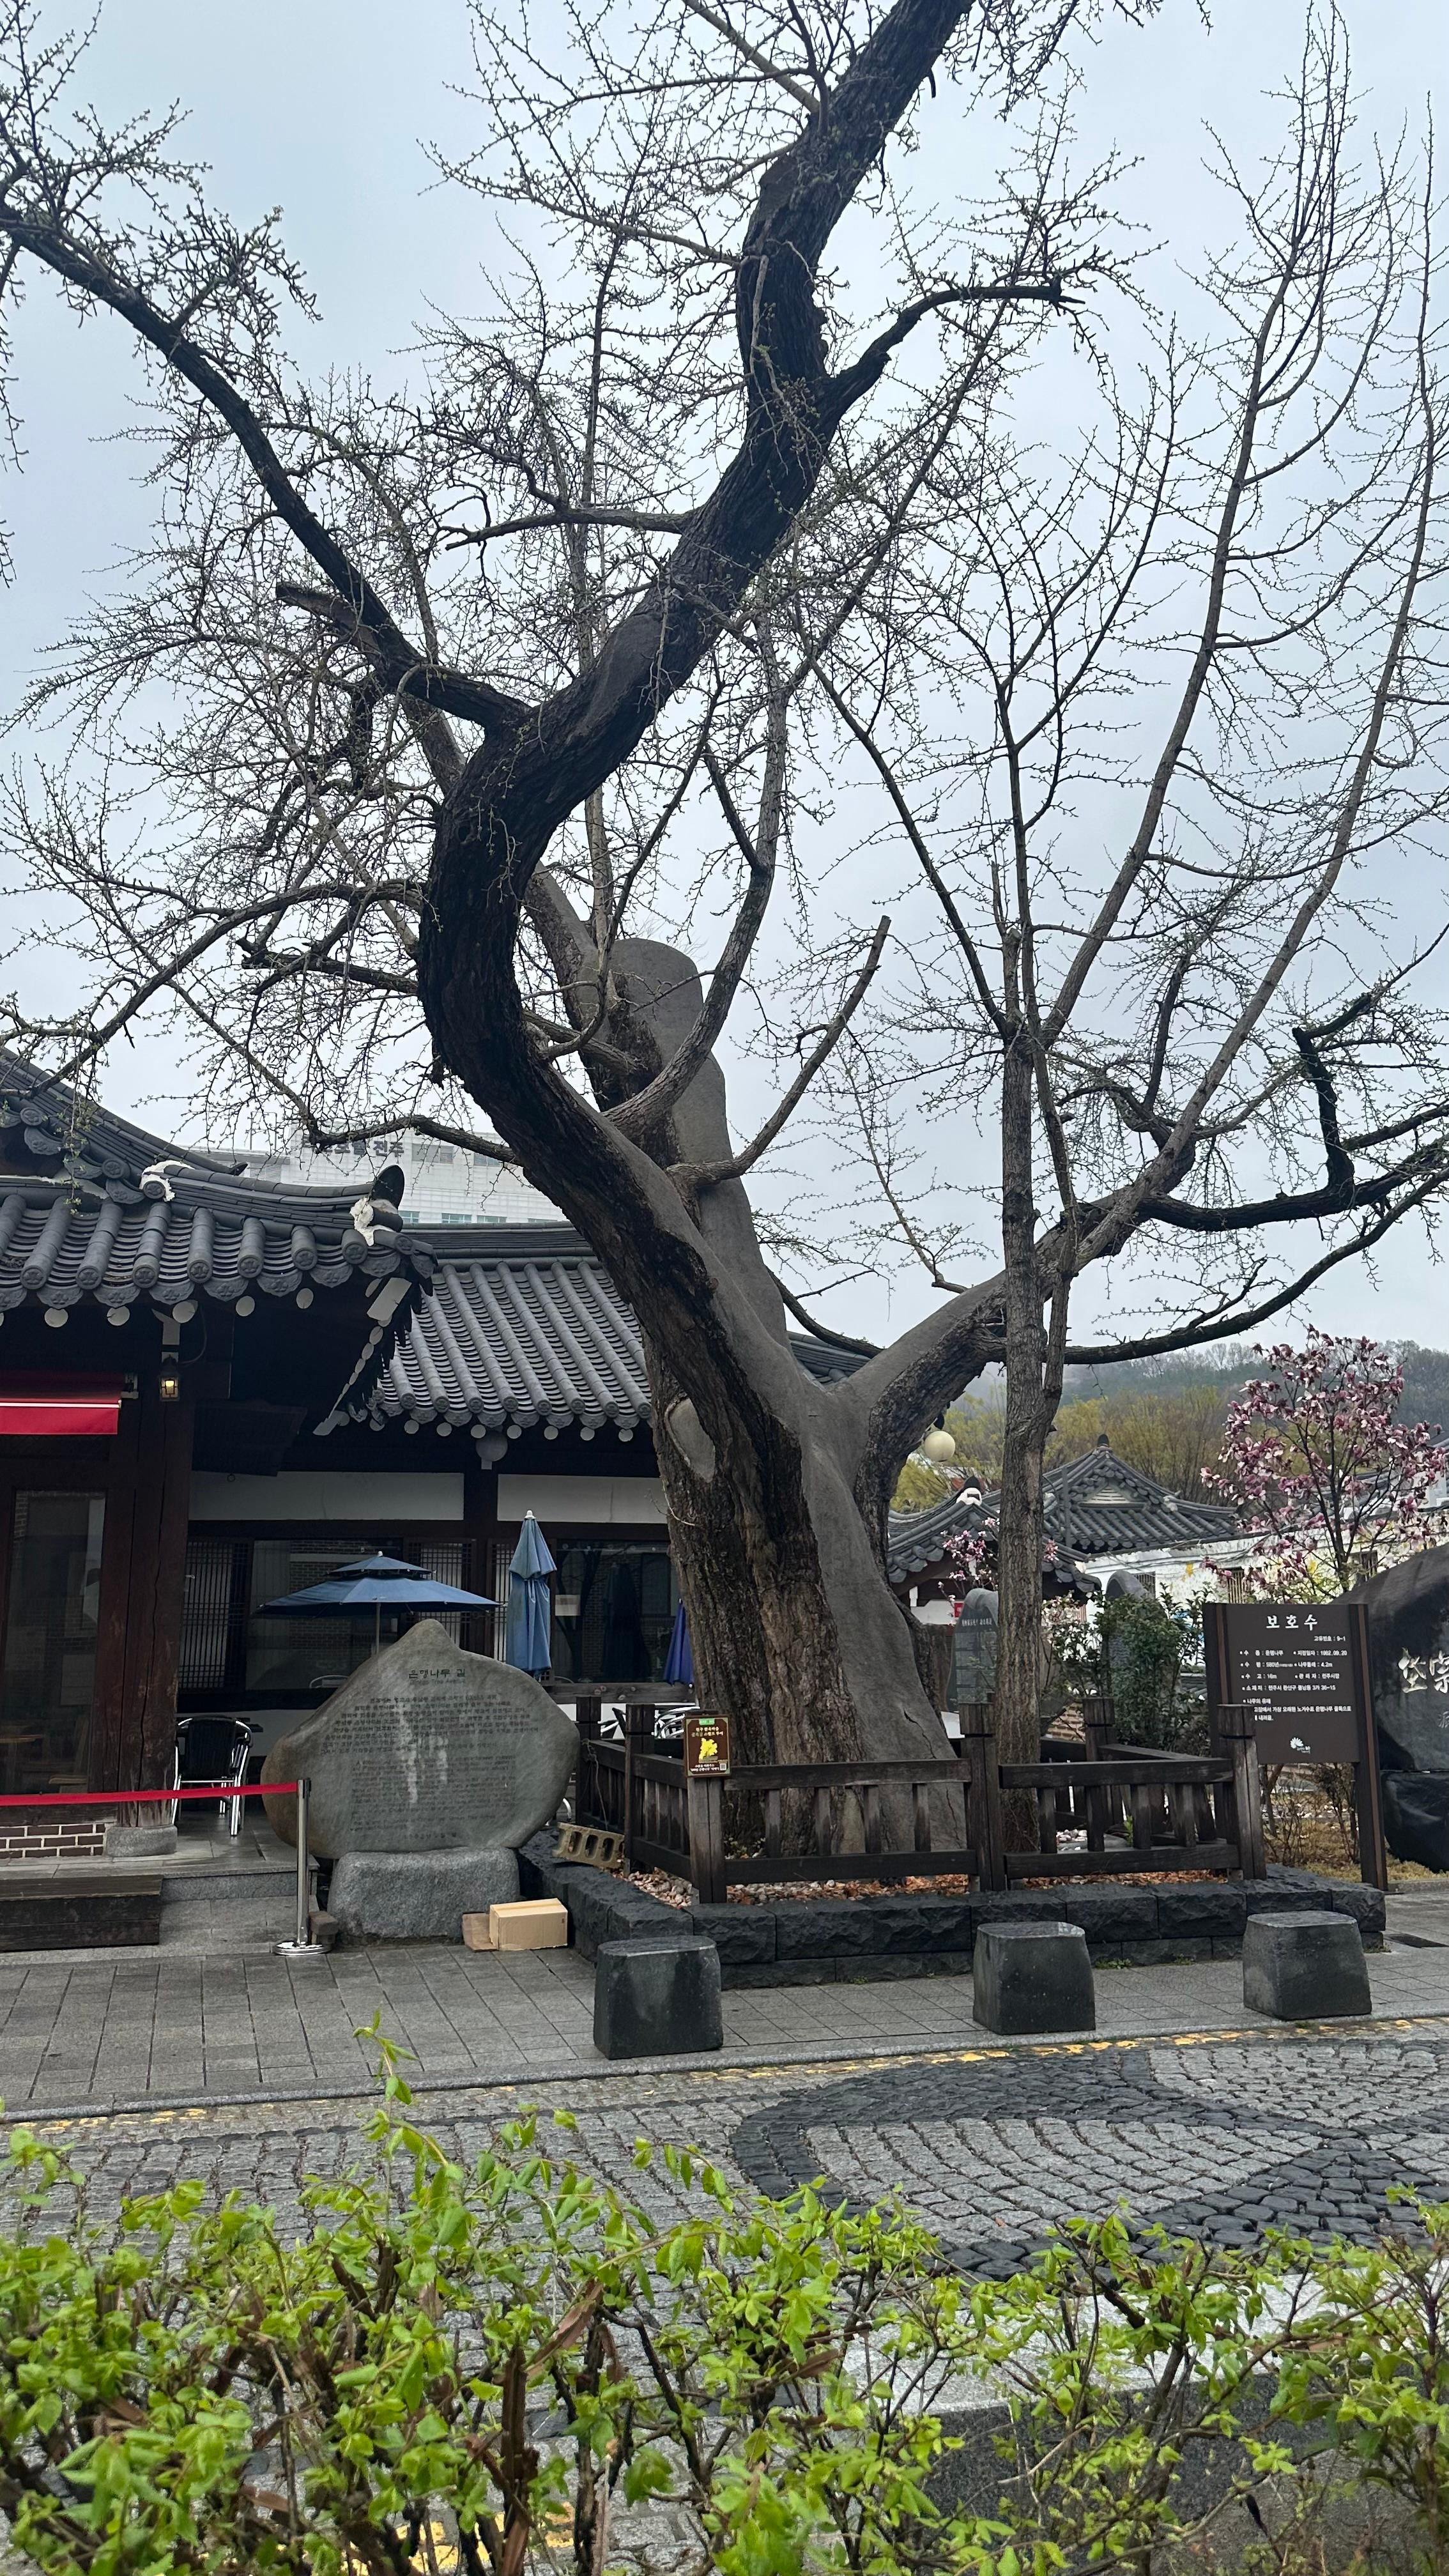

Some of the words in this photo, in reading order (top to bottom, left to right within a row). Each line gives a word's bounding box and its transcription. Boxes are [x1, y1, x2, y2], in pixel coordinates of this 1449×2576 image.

[373, 1140, 404, 1157] 전주
[1266, 1614, 1318, 1631] 보호수
[409, 1669, 450, 1678] 은행나무
[456, 1668, 465, 1677] 길
